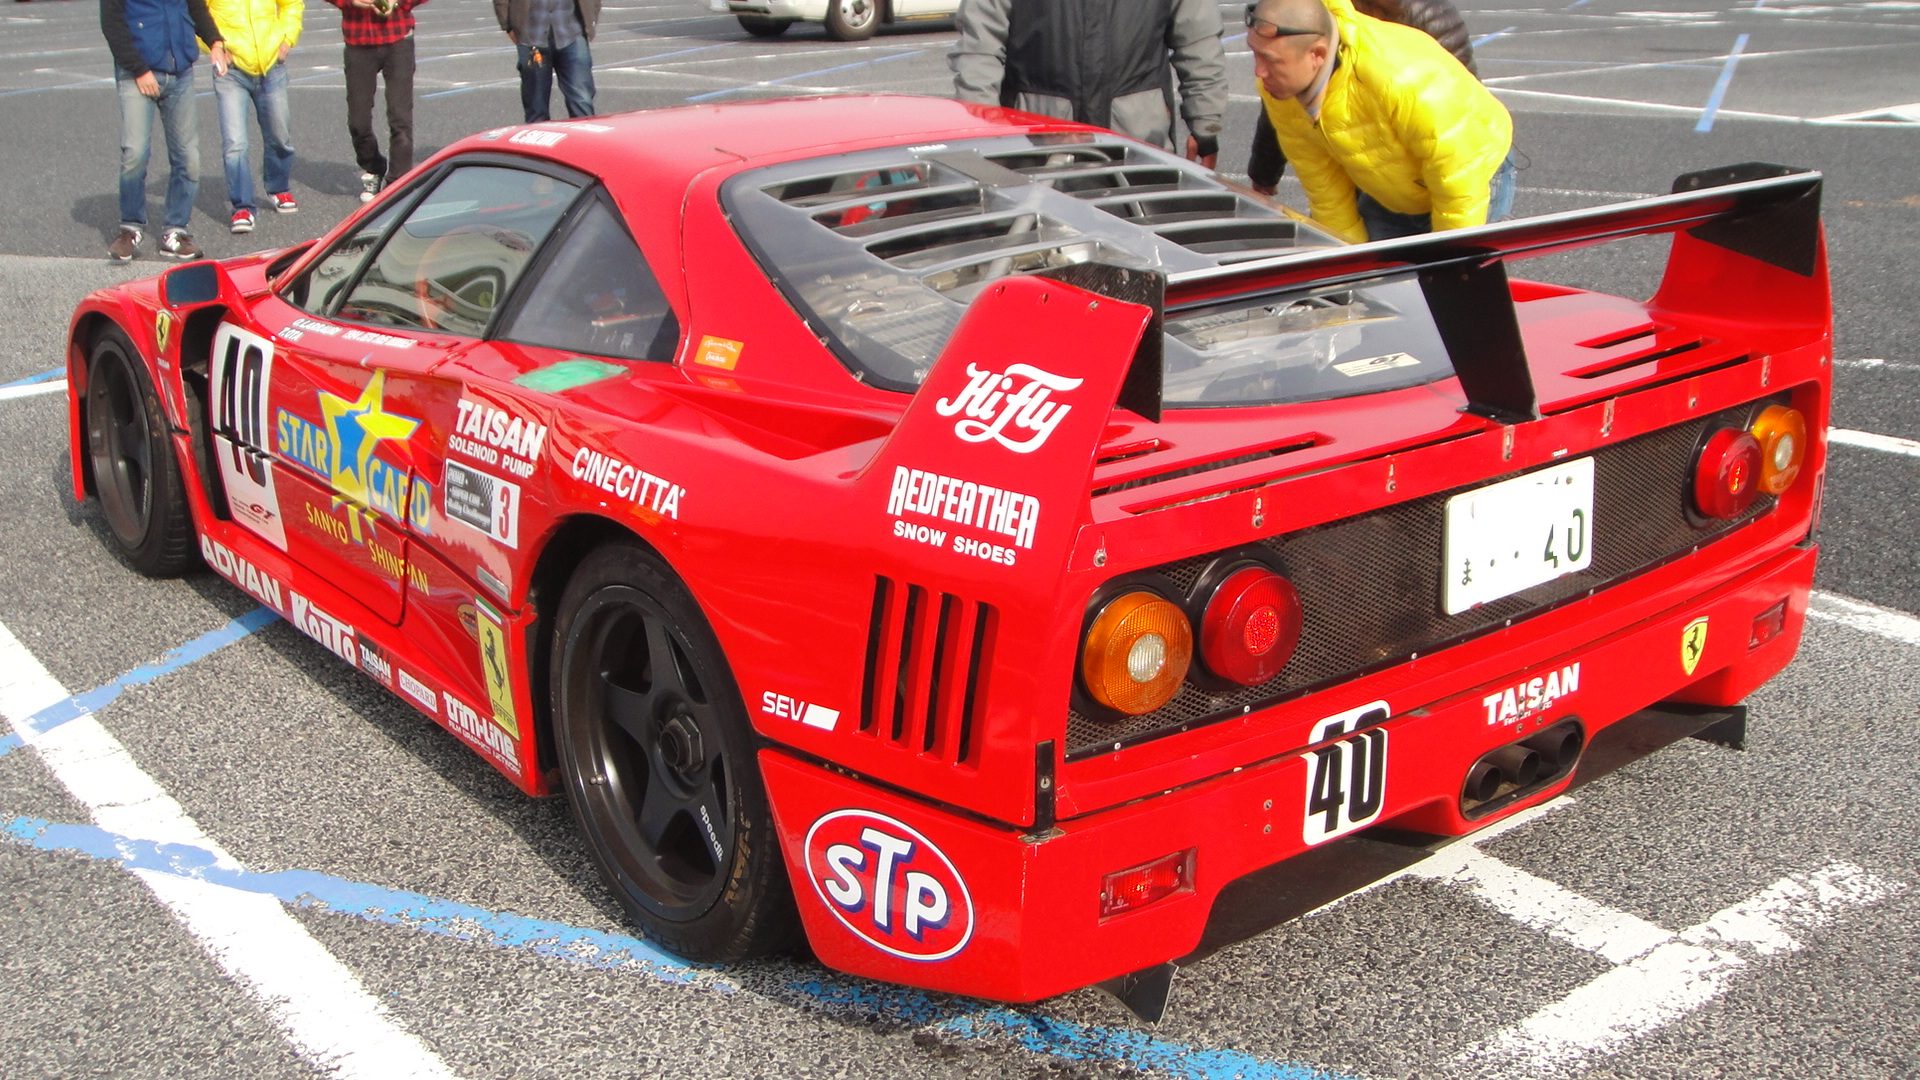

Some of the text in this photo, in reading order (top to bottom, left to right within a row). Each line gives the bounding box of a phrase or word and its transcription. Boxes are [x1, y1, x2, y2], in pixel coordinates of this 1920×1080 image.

[219, 334, 265, 488] 40
[457, 399, 547, 460] TAISAN
[936, 362, 1084, 453] HiFly
[277, 411, 430, 529] STAR CARD
[449, 434, 534, 478] SOLENOID PUMP
[499, 486, 511, 539] 3
[887, 465, 1041, 549] REDFEATHER
[893, 520, 1016, 567] SNOW SHOES
[202, 534, 283, 612] ADVAN
[305, 501, 349, 545] SANYO
[368, 539, 430, 596] SHINPAN
[359, 643, 392, 679] TAISAN
[1483, 662, 1580, 727] TAISAN
[762, 691, 805, 721] SEV
[1308, 707, 1386, 834] 40
[824, 827, 953, 941] STP
